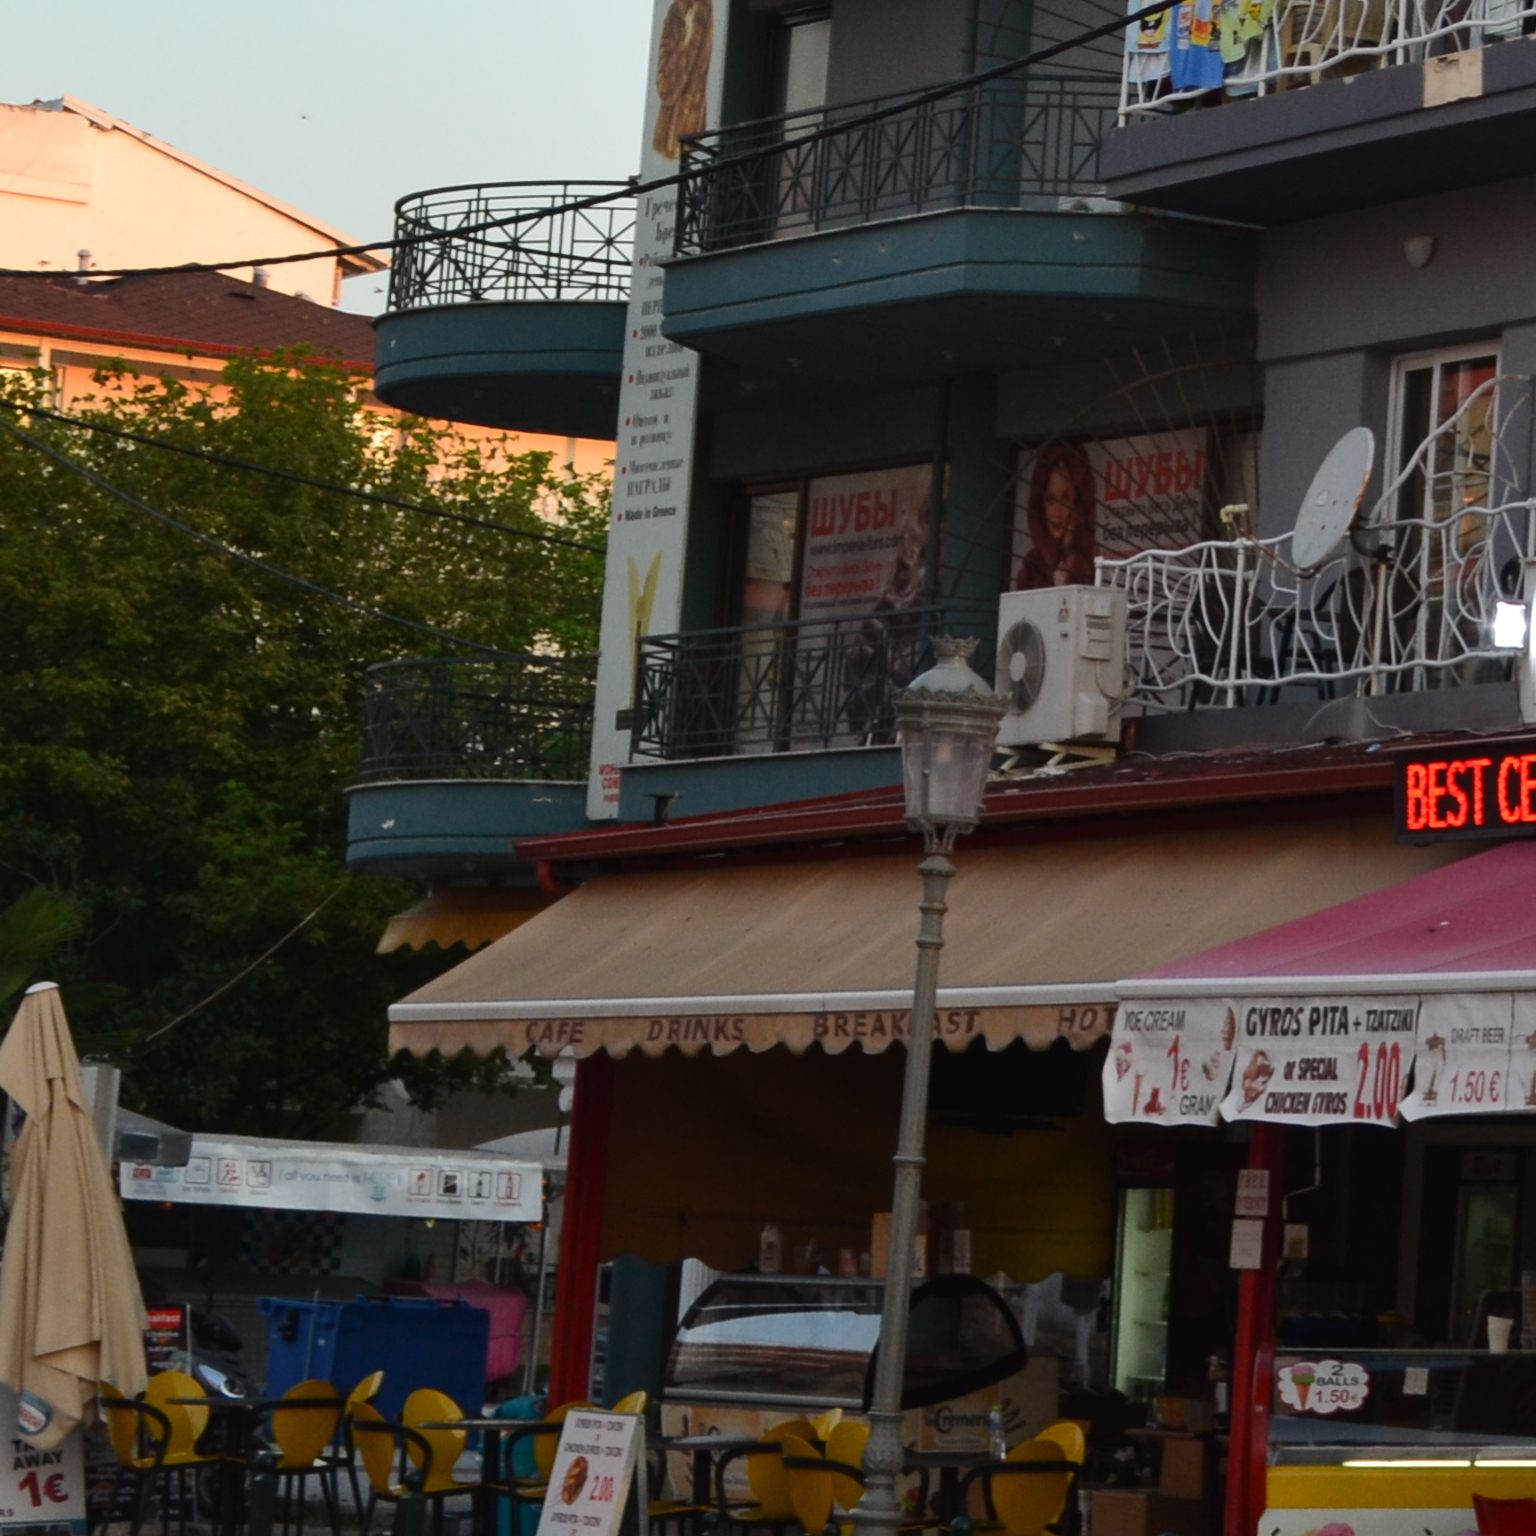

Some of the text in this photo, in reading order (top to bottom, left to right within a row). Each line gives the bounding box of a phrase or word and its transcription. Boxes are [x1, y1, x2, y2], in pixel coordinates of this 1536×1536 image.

[1104, 449, 1203, 501] ШУБЫ
[811, 488, 897, 536] ШУБЫ
[1407, 759, 1490, 831] BEST
[525, 1020, 585, 1044] CAFE
[646, 1017, 745, 1042] DRINKS
[813, 1011, 980, 1039] BREAKAST
[1144, 1010, 1186, 1032] CREAM
[1246, 1006, 1414, 1037] GYROS PITA TZATZIKI
[1298, 1057, 1338, 1080] SPECIAL
[1264, 1092, 1347, 1114] CHICKEN GYROS
[1315, 1376, 1360, 1387] BALLS
[1331, 1364, 1344, 1376] 2
[13, 1450, 64, 1470] AWAY
[19, 1472, 69, 1507] 1€
